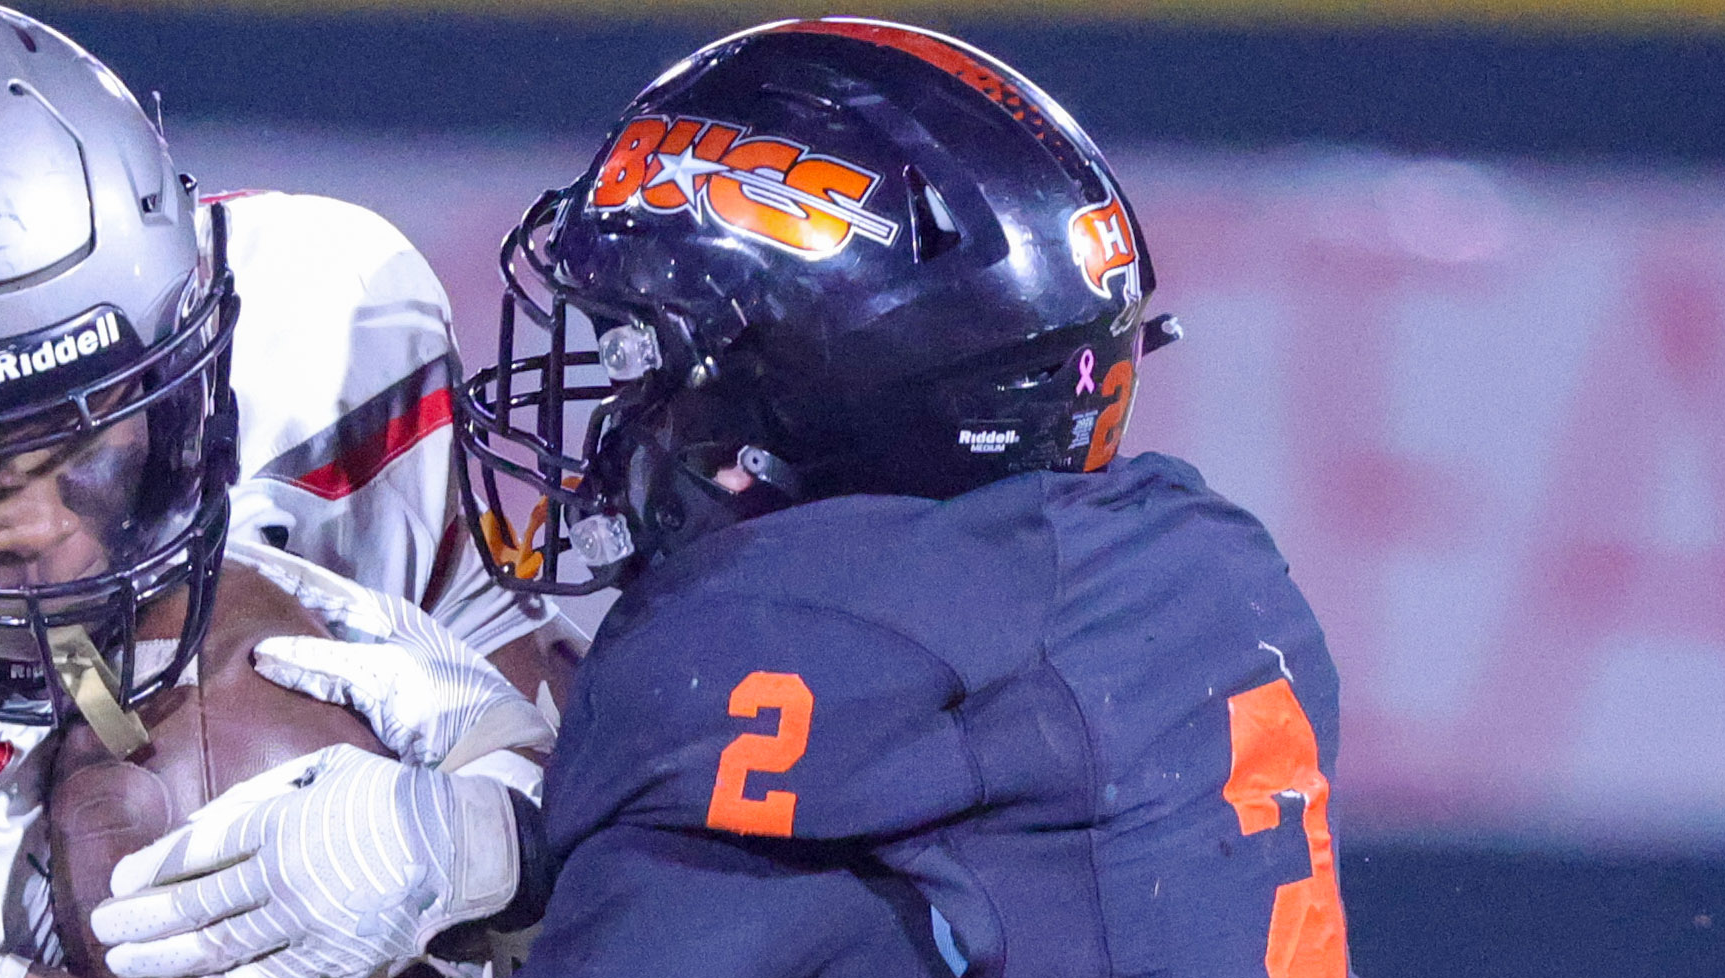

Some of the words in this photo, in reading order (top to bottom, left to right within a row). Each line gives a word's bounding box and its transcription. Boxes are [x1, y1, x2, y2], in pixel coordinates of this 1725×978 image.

[584, 114, 883, 261] BUCS
[1094, 214, 1129, 262] H
[958, 430, 1016, 444] Riddell
[1082, 360, 1134, 473] 2
[706, 671, 815, 838] 2
